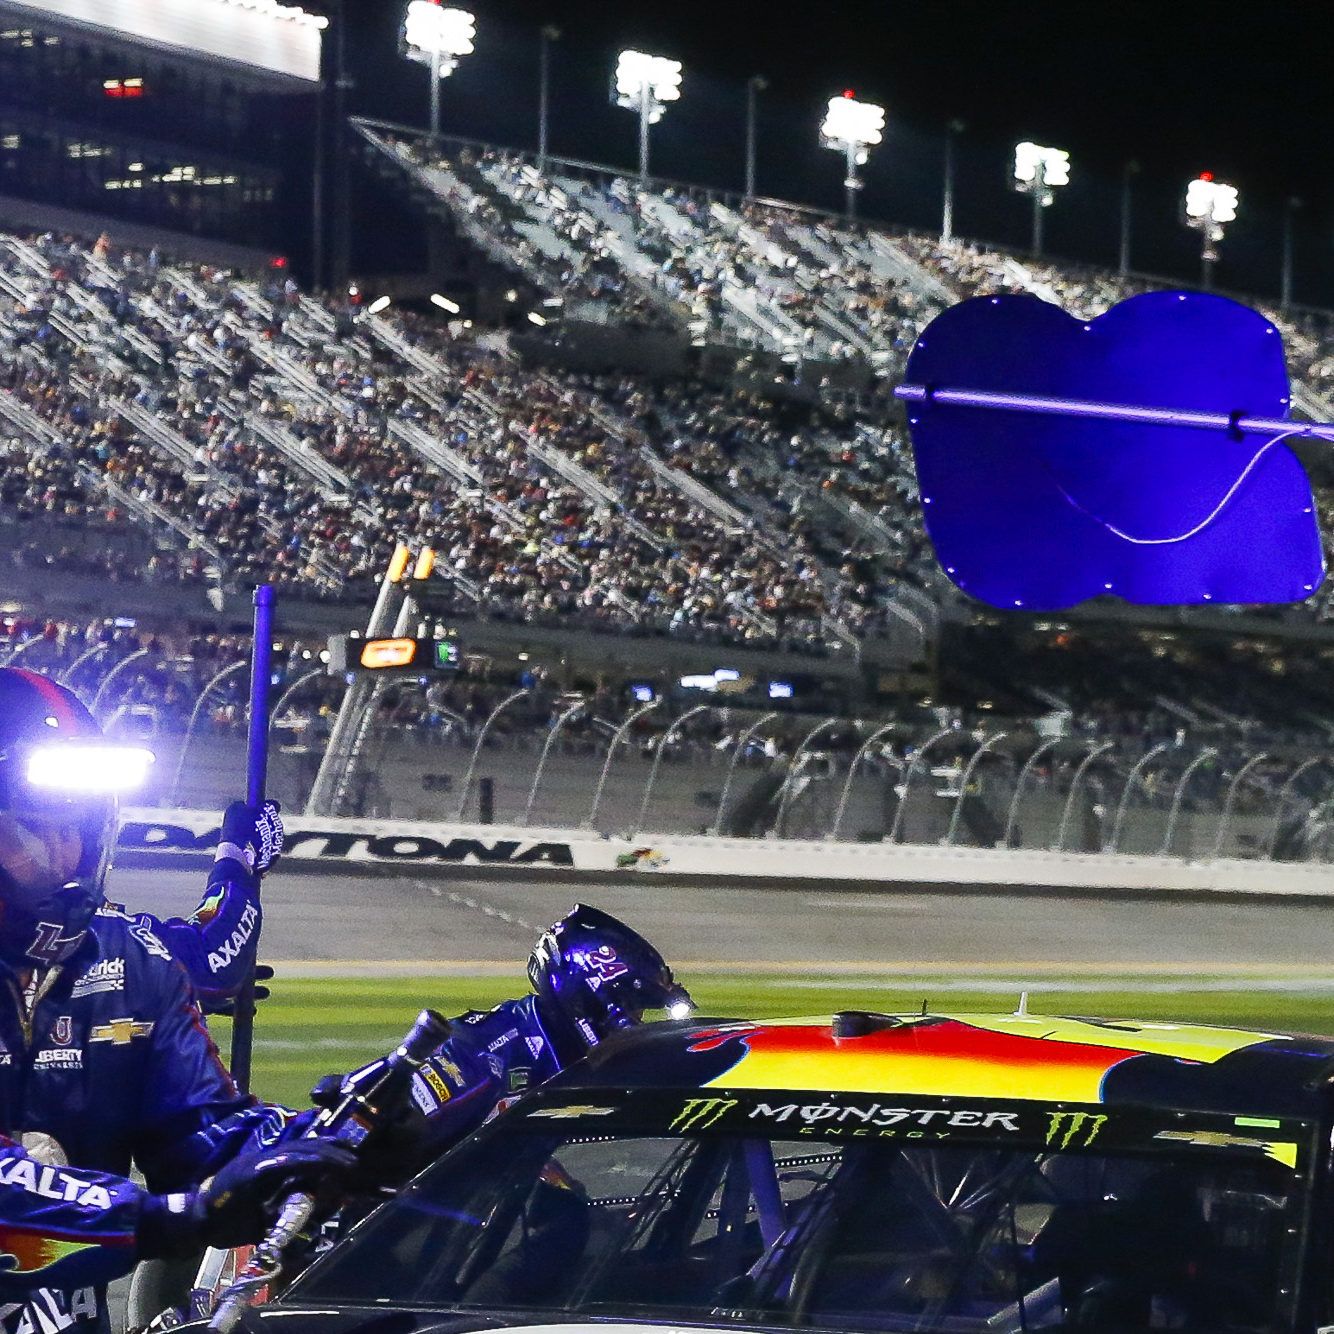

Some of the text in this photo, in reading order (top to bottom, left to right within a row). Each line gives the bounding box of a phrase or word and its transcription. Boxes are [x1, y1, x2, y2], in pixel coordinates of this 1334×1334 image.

[208, 902, 259, 973] AXALTA
[583, 944, 629, 983] 24
[429, 1072, 450, 1102] BOSCH
[799, 1127, 951, 1139] ENERGY
